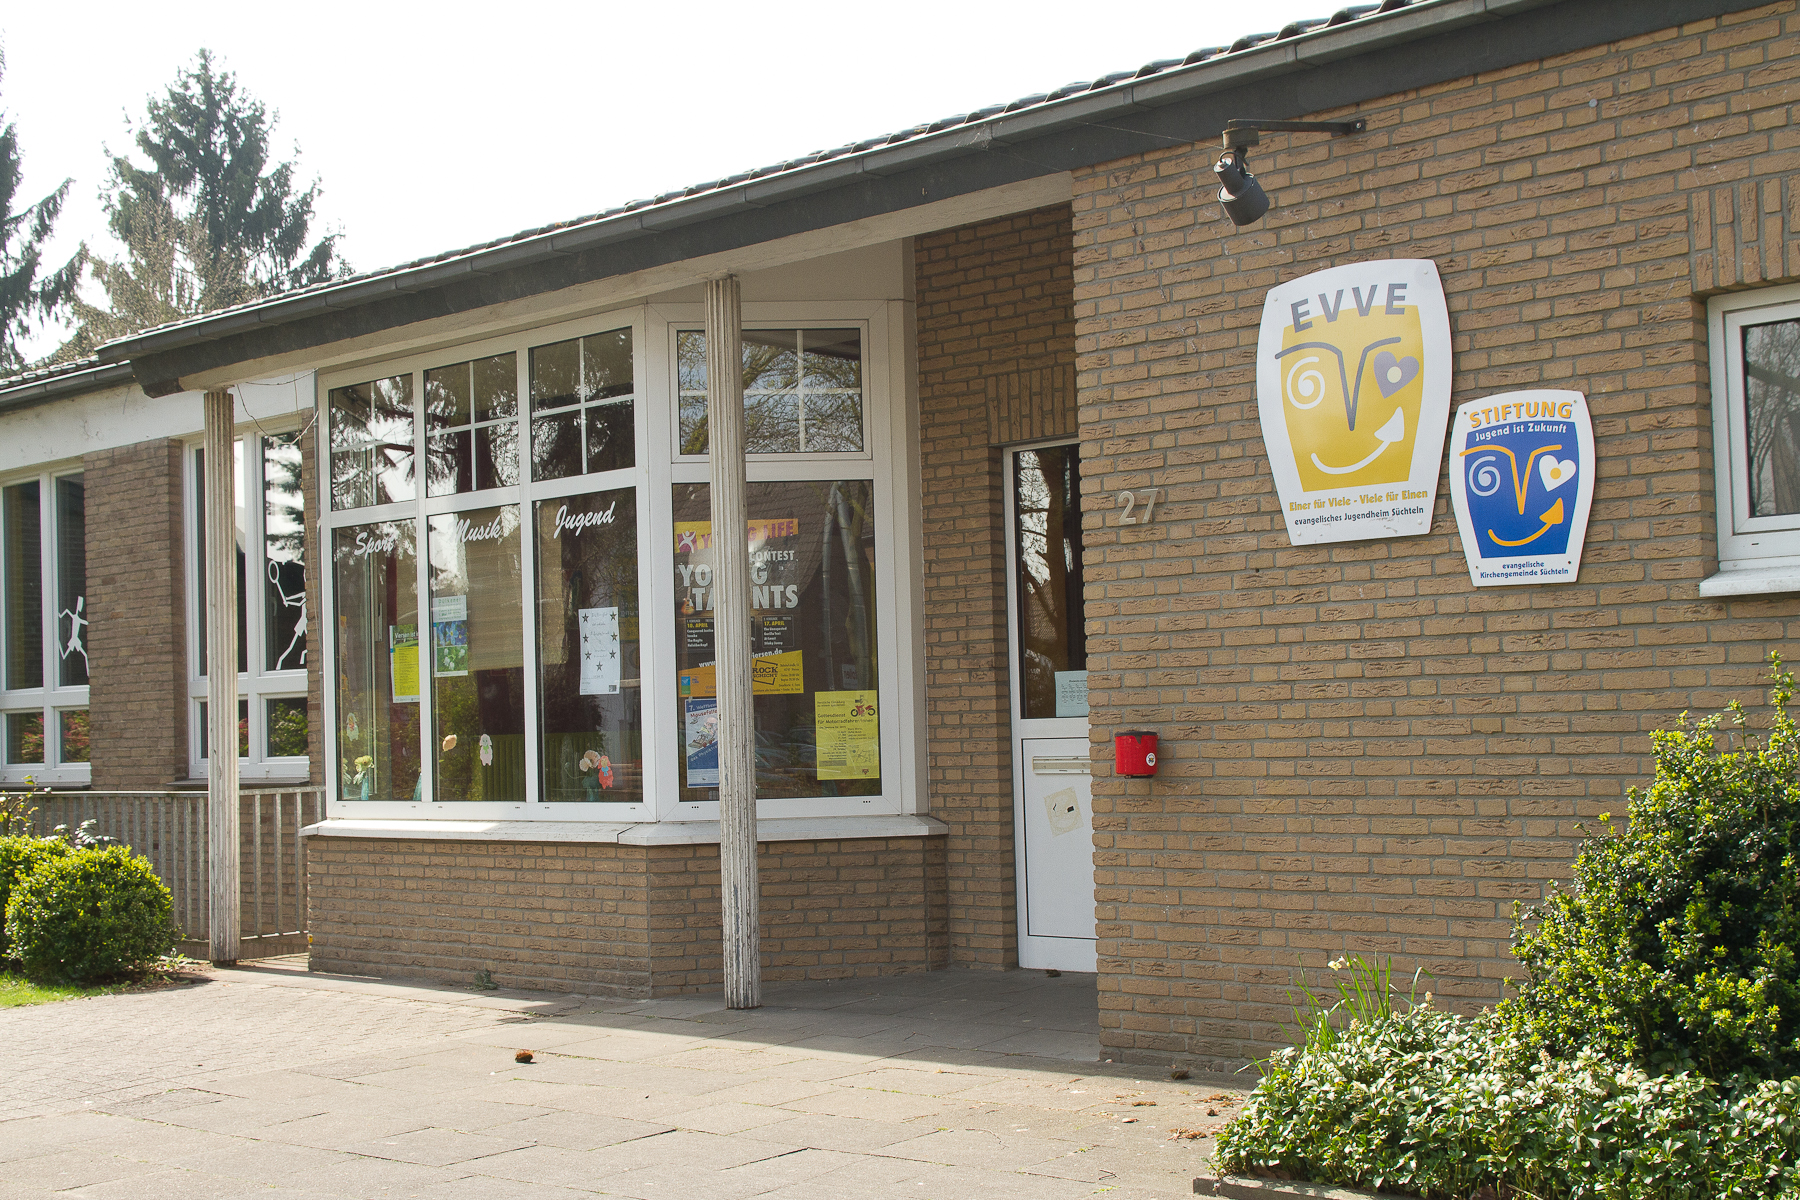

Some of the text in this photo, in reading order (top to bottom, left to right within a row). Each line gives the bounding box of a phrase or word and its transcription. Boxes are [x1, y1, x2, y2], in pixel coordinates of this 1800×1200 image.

[1290, 283, 1408, 333] EVVE
[1469, 401, 1572, 428] STIFTUNG
[1475, 423, 1567, 442] Jugend ist Zukunft
[1117, 488, 1159, 525] 27
[1289, 501, 1311, 512] Einer
[1313, 499, 1326, 510] für
[1328, 497, 1351, 508] Viele
[1359, 493, 1383, 504] Viele
[1385, 491, 1399, 502] für
[1401, 490, 1428, 501] Einen
[553, 500, 616, 539] Jugend
[1294, 506, 1424, 526] evangelisches Jugendheim Süchteln
[450, 515, 502, 544] Musik
[763, 520, 794, 540] LIFE
[354, 531, 395, 560] Sport
[749, 549, 795, 562] CONTEST
[1480, 567, 1569, 579] Kirchengemeinde Süchteln
[1502, 561, 1545, 570] evangelische
[752, 666, 778, 674] ROCK
